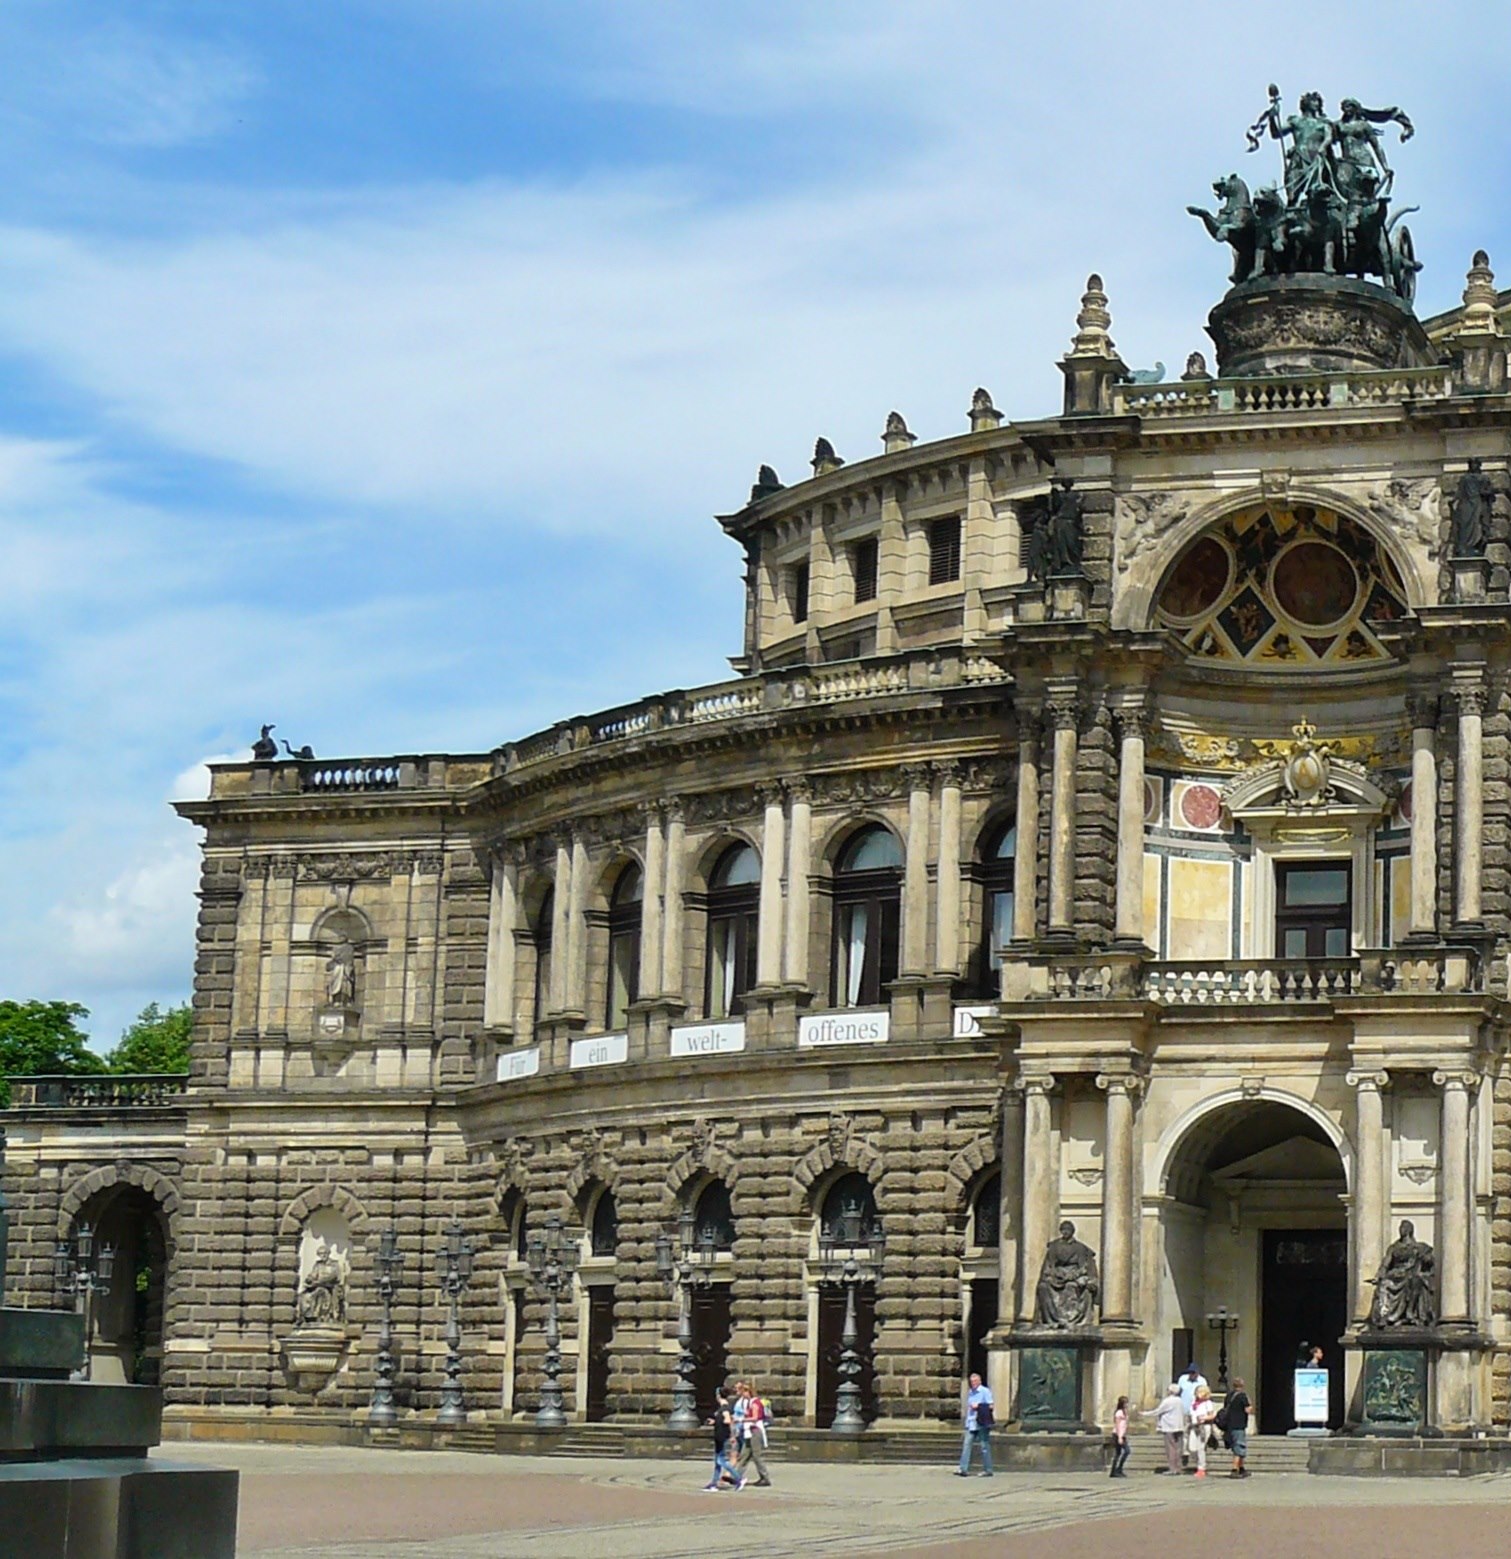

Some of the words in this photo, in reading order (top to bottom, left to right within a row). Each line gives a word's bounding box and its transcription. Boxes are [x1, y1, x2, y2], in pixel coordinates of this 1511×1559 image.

[687, 1029, 727, 1051] welt-
[808, 1019, 879, 1042] offenes
[588, 1041, 608, 1064] ein
